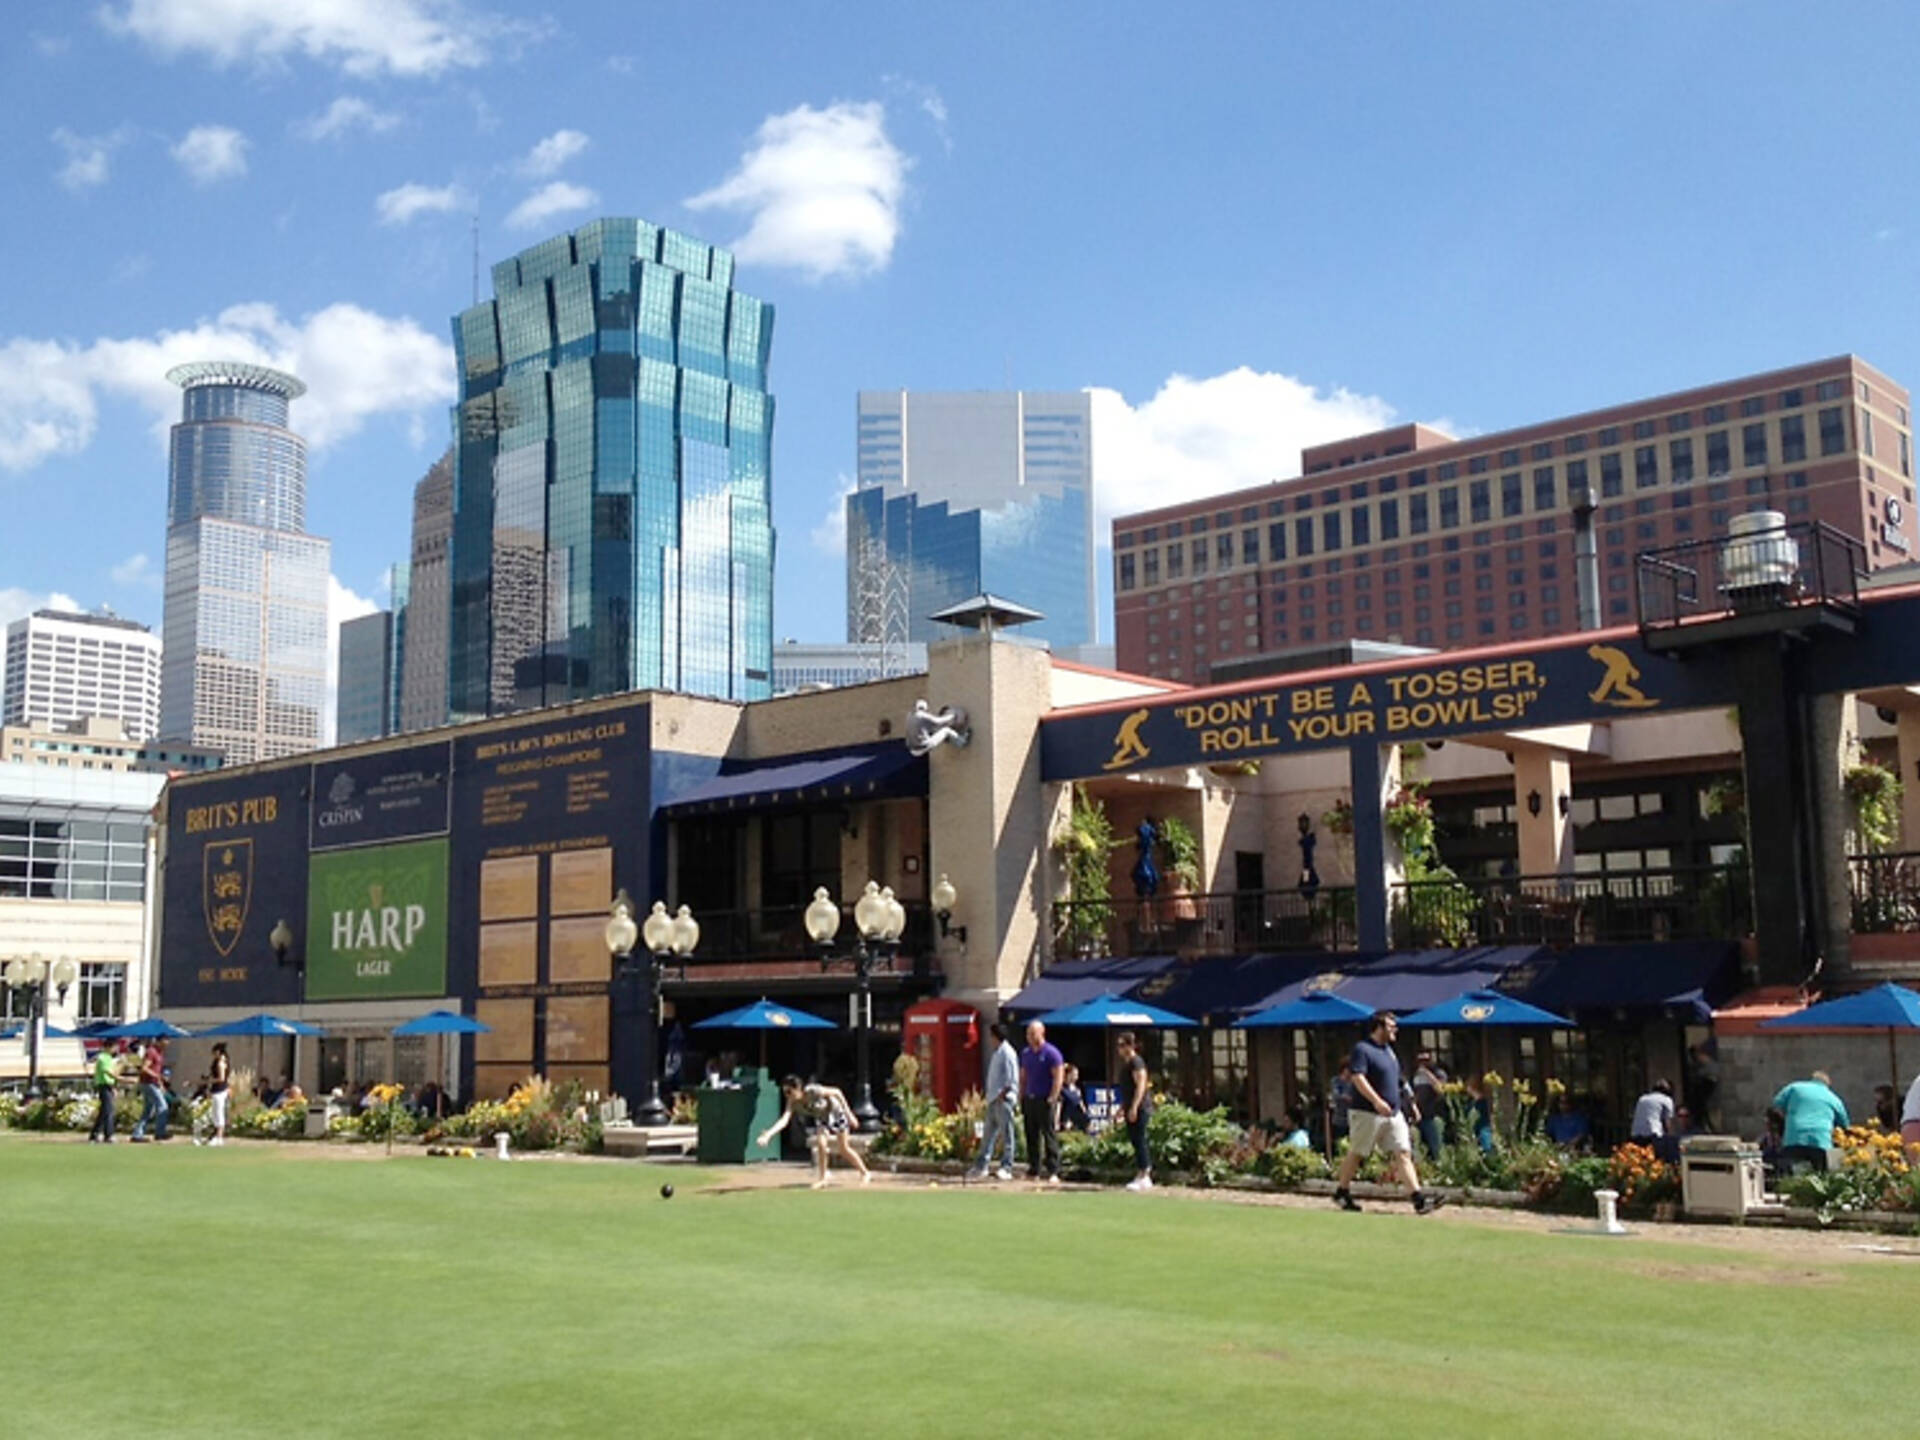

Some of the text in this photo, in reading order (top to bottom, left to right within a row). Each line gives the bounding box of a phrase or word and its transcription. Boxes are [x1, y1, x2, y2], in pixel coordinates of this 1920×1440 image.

[1174, 660, 1547, 728] "DON'T BE A TOSSER,
[1201, 690, 1538, 752] ROLL YOUR BOWLS!"
[185, 796, 278, 834] BRIT'S PUB
[331, 904, 426, 953] HARP
[356, 960, 392, 977] LAGER
